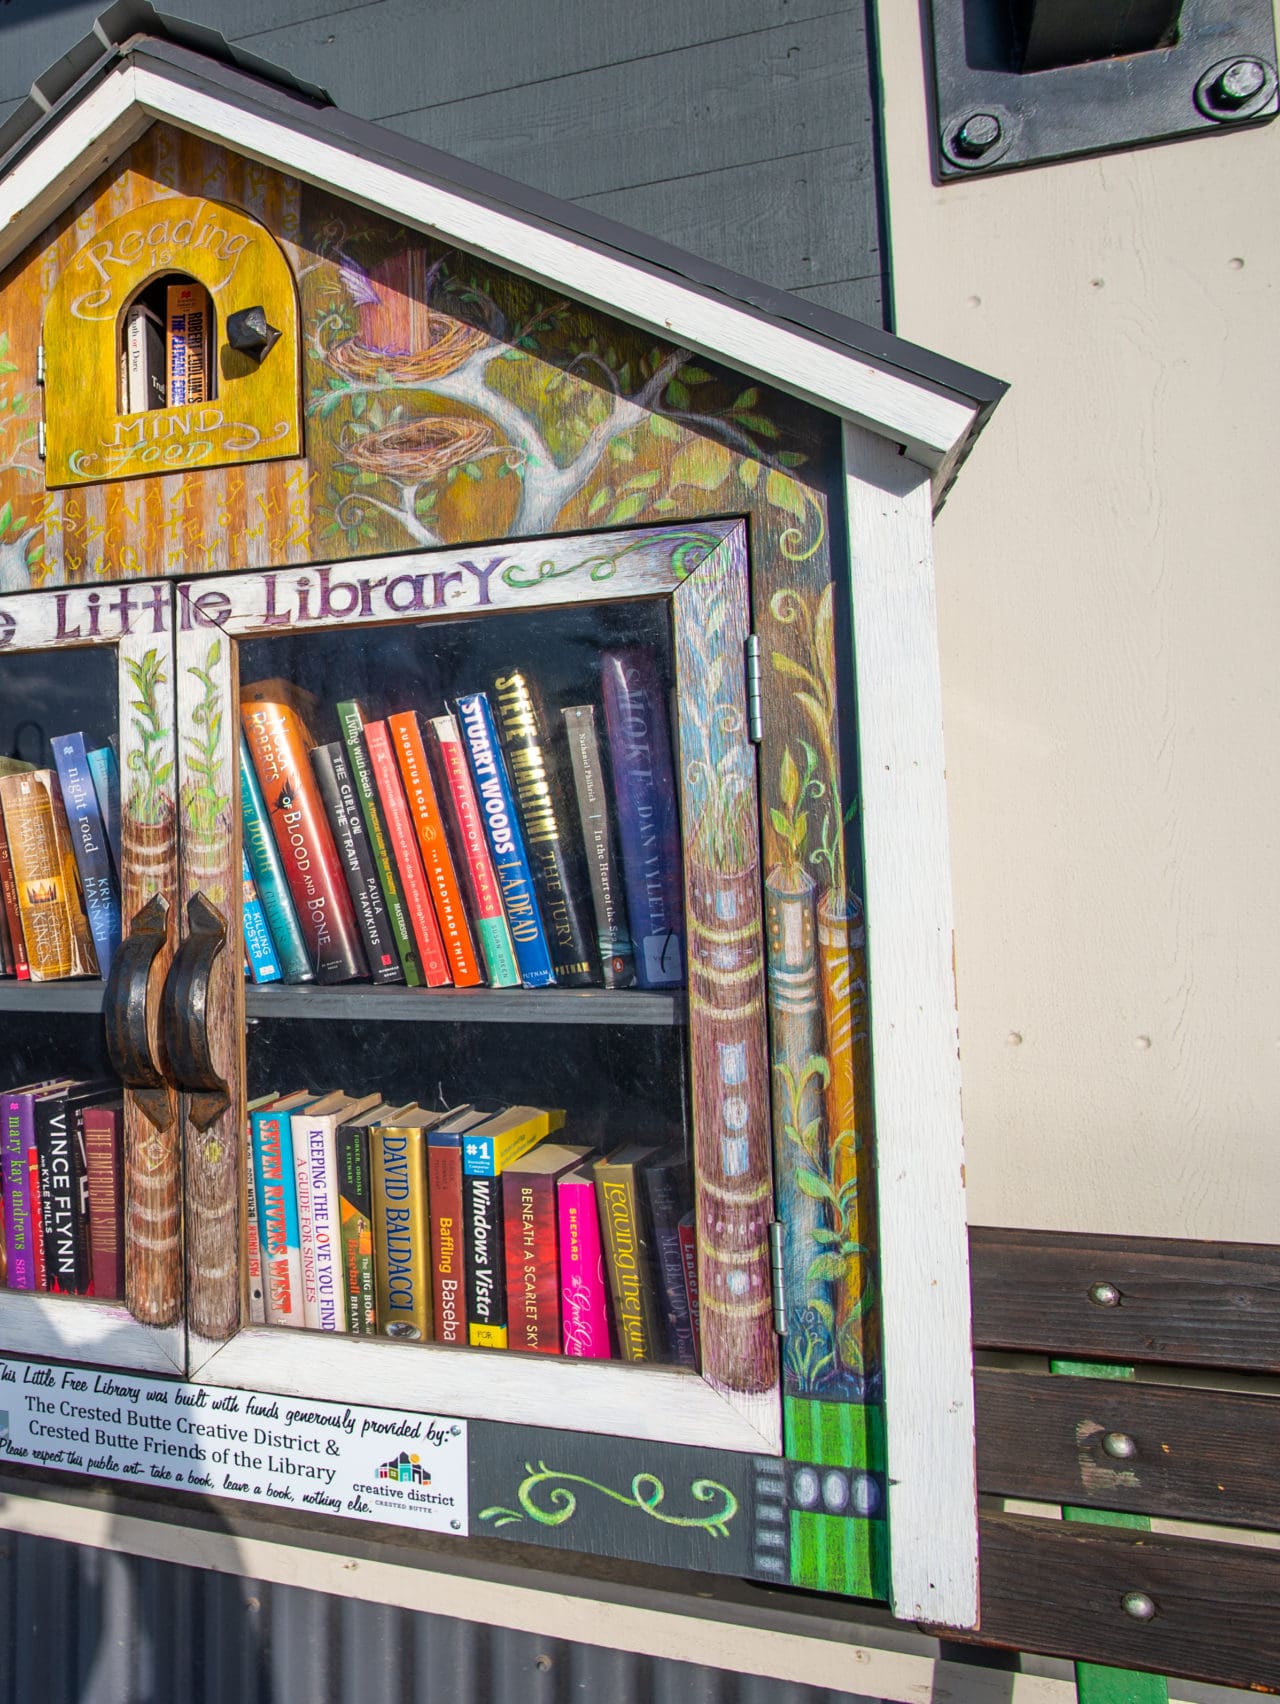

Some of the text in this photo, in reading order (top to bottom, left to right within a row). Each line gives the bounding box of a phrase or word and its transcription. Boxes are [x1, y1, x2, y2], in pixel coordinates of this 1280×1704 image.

[76, 201, 255, 294] Reading
[152, 249, 172, 267] is
[131, 310, 140, 373] Truth or Dare
[171, 315, 186, 332] THE
[187, 311, 203, 350] ROBERT
[187, 353, 203, 404] LUDLUM'S
[54, 584, 232, 639] Little
[345, 712, 360, 745] Living
[359, 770, 374, 799] Bears
[399, 727, 429, 819] AUGUSTUS ROSE
[460, 700, 516, 855] STUART WOODS
[495, 672, 560, 844] STEVE MARTINI
[68, 767, 99, 854] night road
[333, 756, 363, 835] THE GIRL ON
[334, 800, 361, 871] THE TRAIN
[448, 748, 495, 912] THE FICTION CLASS
[594, 830, 603, 841] In
[595, 843, 606, 860] the
[282, 795, 331, 946] OF BLOOD AND BONE
[366, 877, 383, 914] PAULA
[497, 860, 539, 943] L.A. DEAD
[540, 851, 574, 948] THE JURY
[599, 862, 610, 891] Heart
[604, 892, 612, 904] of
[84, 876, 108, 942] HANNAH
[243, 912, 263, 959] CUSTER
[252, 911, 272, 956] KILLING
[359, 891, 381, 946] HAWKINS
[434, 867, 468, 974] READYMADE THIEF
[606, 907, 615, 923] the
[6, 1116, 28, 1250] mary kay andrews
[41, 1168, 51, 1198] KYLE
[466, 1141, 491, 1160] #1
[43, 1201, 53, 1234] MILLS
[49, 1113, 75, 1273] VINCE FLYNN
[259, 1119, 292, 1314] SEVEN RIVERS WEST
[382, 1136, 414, 1312] DAVID BALDACCI
[472, 1180, 492, 1265] Windows
[309, 1130, 336, 1332] KEEPING THE LOVE YOU FIND
[439, 1217, 455, 1274] Baffling
[569, 1207, 579, 1262] SHEPARD
[602, 1181, 641, 1312] Leaving the
[521, 1187, 538, 1349] BENEATH A SCARLET SKY
[23, 1366, 56, 1388] Little
[61, 1371, 88, 1392] Free
[93, 1375, 141, 1404] Library
[146, 1390, 169, 1403] was
[175, 1388, 210, 1408] built
[212, 1395, 240, 1413] with
[246, 1396, 280, 1420] funds
[283, 1407, 357, 1435] generously
[361, 1419, 422, 1439] provided
[424, 1420, 451, 1447] by:
[25, 1395, 341, 1456] The Crested Butte Creative District &
[28, 1419, 337, 1485] Crested Butte Friends of the Library
[32, 1448, 65, 1466] respect
[64, 1450, 83, 1467] this
[87, 1454, 120, 1472] public
[150, 1463, 173, 1481] take
[175, 1473, 184, 1482] a
[188, 1470, 215, 1488] book,
[223, 1474, 250, 1493] leave
[253, 1486, 262, 1495] a
[266, 1483, 295, 1503] book,
[303, 1492, 342, 1513] nothing
[347, 1495, 373, 1514] else.
[352, 1483, 455, 1507] creative district
[374, 1500, 433, 1514] CRESTED BUTTE
